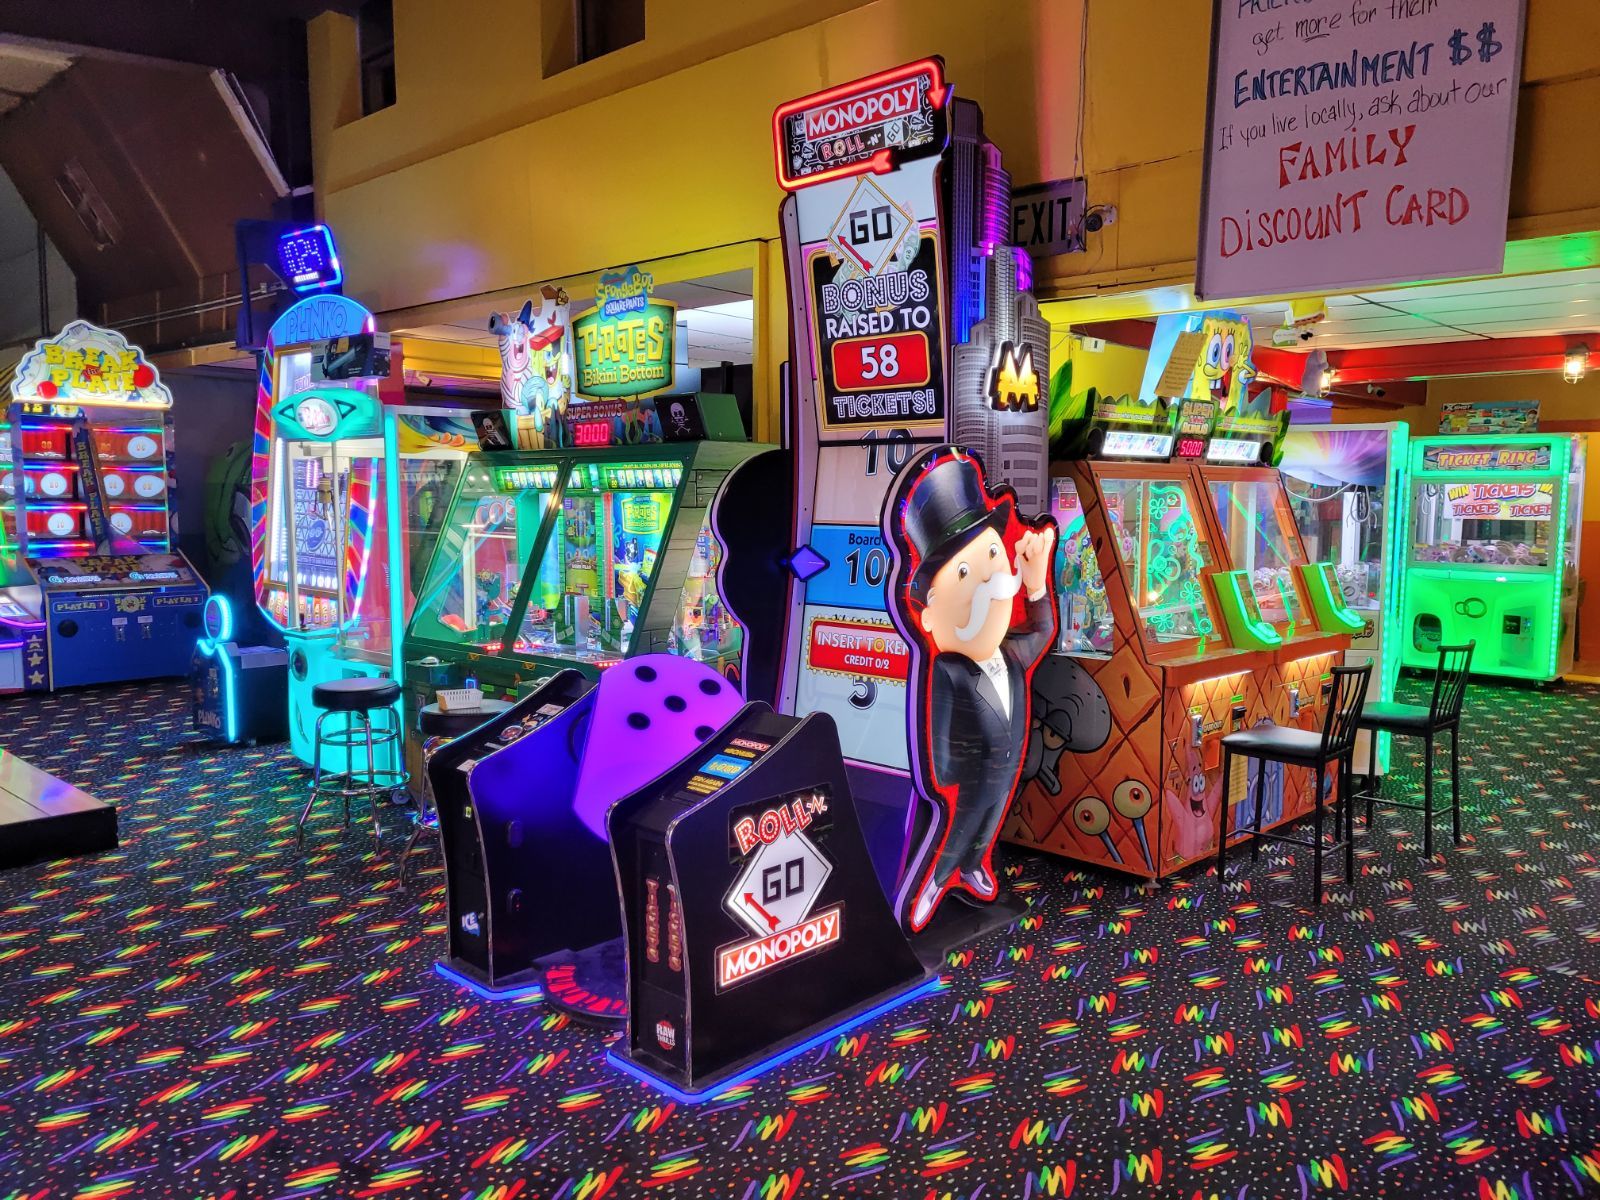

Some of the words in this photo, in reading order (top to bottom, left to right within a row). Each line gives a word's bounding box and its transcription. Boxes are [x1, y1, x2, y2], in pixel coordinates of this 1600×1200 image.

[1252, 25, 1284, 56] get
[1295, 13, 1342, 40] more
[1349, 6, 1377, 28] for
[1234, 41, 1435, 109] ENTERTAINMENT
[808, 85, 916, 137] MONOPOLY
[1219, 124, 1235, 151] If
[1240, 124, 1267, 148] you
[1272, 113, 1298, 135] live
[1304, 100, 1364, 131] locally,
[1368, 89, 1402, 116] ask
[1407, 79, 1461, 113] about
[1465, 78, 1508, 103] our
[821, 134, 866, 160] ROLL
[886, 122, 901, 142] GO
[1013, 197, 1072, 247] EXIT
[1385, 184, 1470, 227] CARD
[850, 205, 893, 246] GO
[822, 269, 930, 314] BONUS
[286, 300, 348, 343] PLINKO
[826, 311, 894, 339] RAISED
[900, 306, 931, 330] TO
[44, 344, 139, 373] BREAK
[861, 344, 899, 380] 58
[52, 369, 136, 393] PLATE
[584, 366, 618, 387] Bikini
[620, 365, 665, 384] Bottom
[567, 406, 592, 420] SUPER
[833, 389, 936, 418] TICKETS!
[575, 423, 609, 445] 3000
[1180, 440, 1204, 456] 5000
[861, 429, 916, 476] 10
[1440, 452, 1492, 467] TICKET
[1498, 450, 1537, 465] RING
[1448, 484, 1470, 501] WIN
[1473, 483, 1536, 500] TICKETS
[1452, 502, 1501, 517] TICKETS
[817, 631, 862, 650] INSERT
[844, 654, 874, 667] CREDIT
[875, 658, 890, 670] 0/2
[848, 677, 878, 710] 5
[734, 798, 813, 856] ROLL
[762, 857, 804, 905] GO
[725, 914, 836, 981] MONOPOLY
[656, 1023, 675, 1040] RAW
